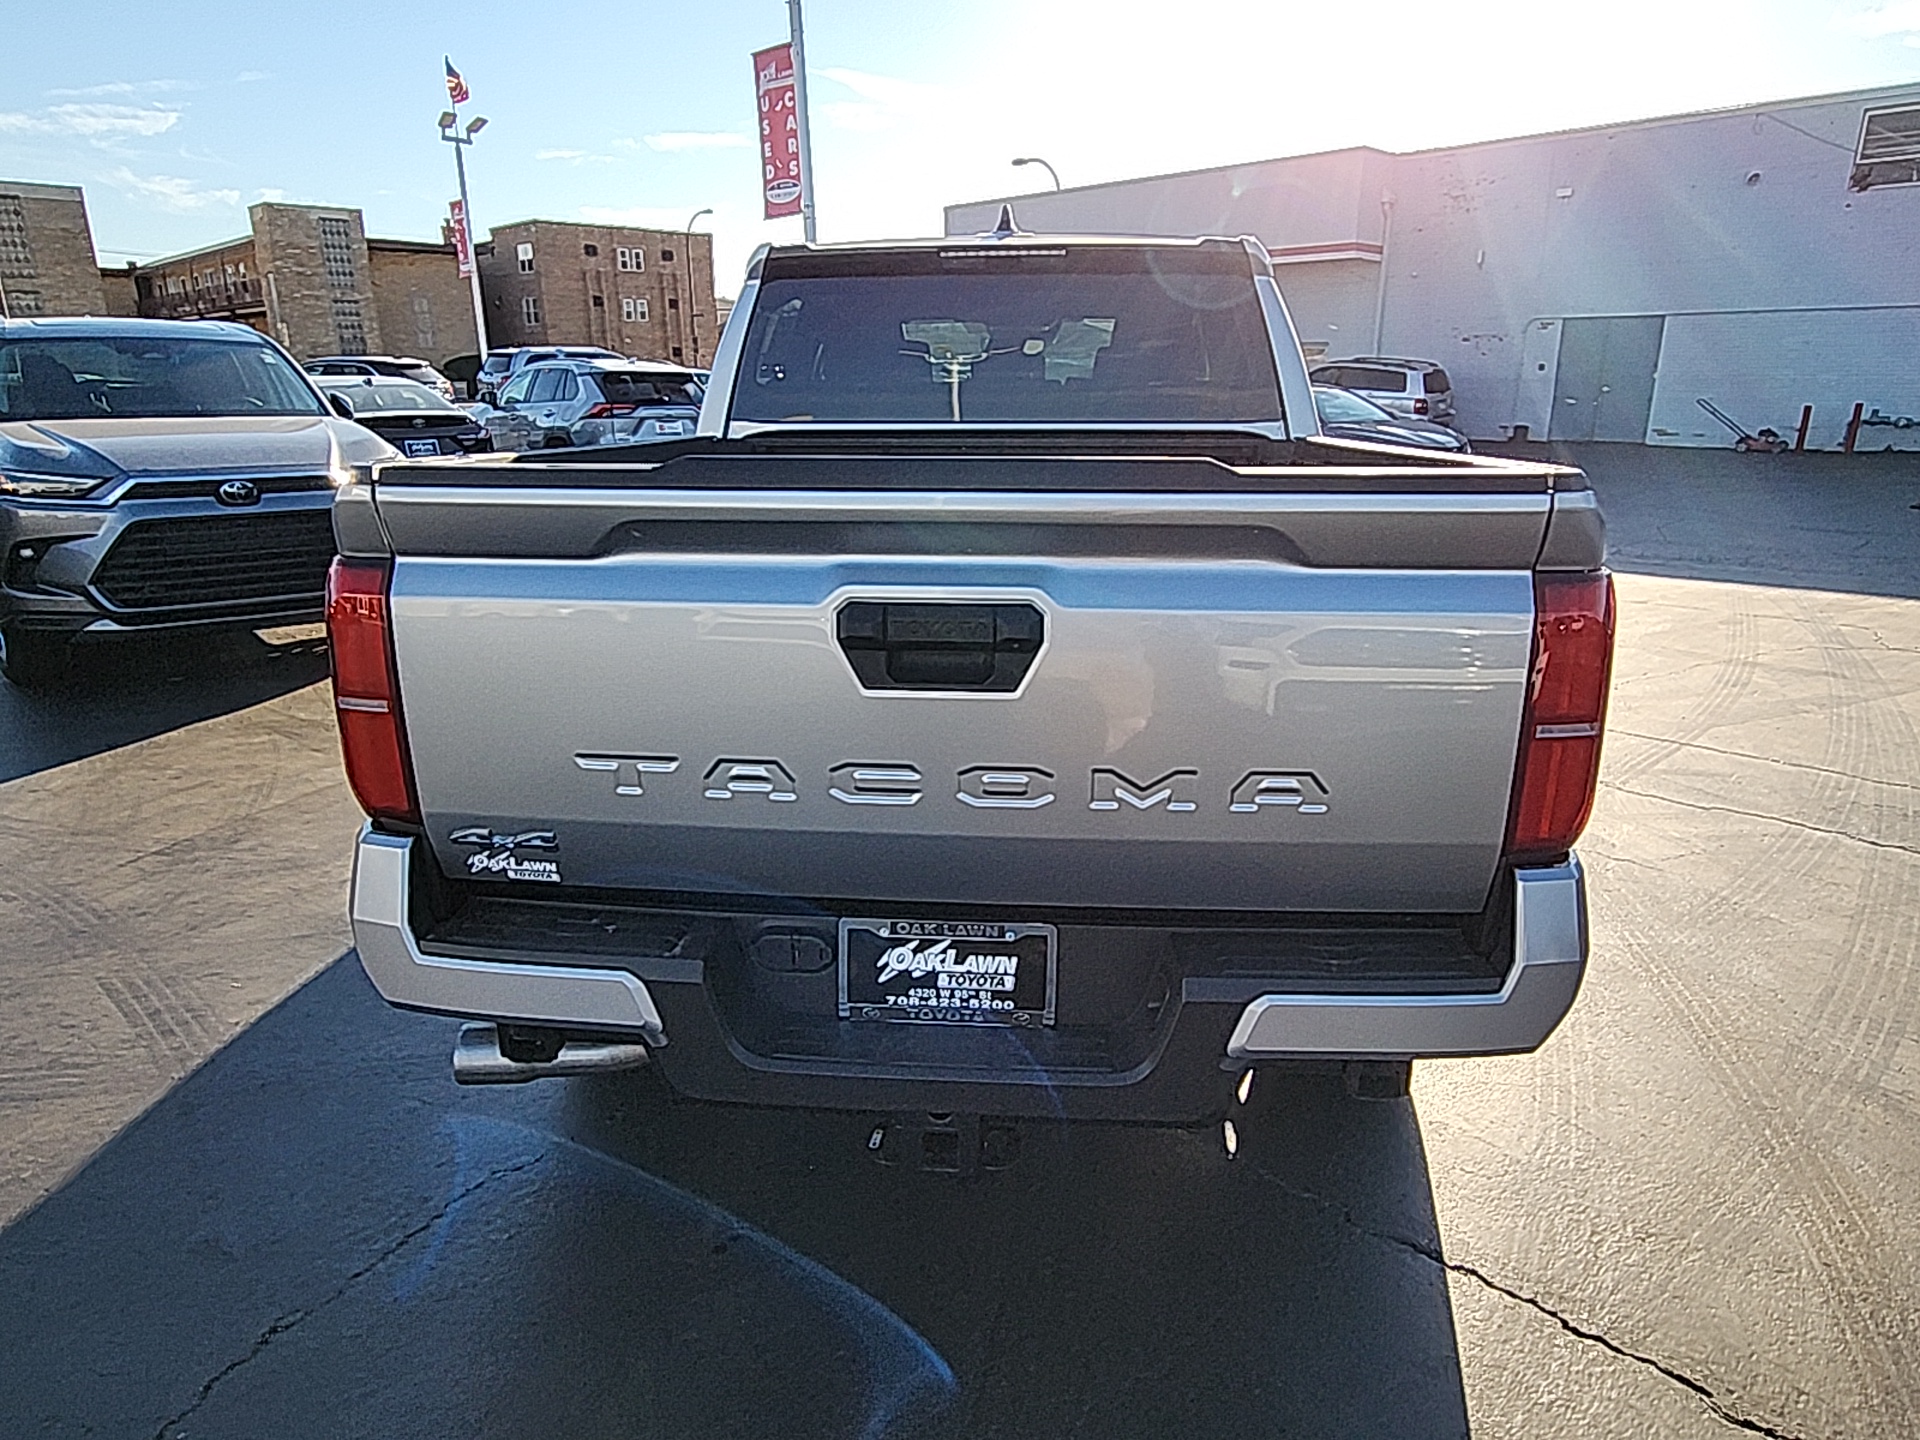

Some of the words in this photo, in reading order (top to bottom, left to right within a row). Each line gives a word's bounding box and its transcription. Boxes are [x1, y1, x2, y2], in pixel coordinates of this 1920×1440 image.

[760, 95, 775, 179] USED
[784, 91, 799, 176] CARS
[891, 618, 987, 637] TOYOTA
[574, 751, 1330, 813] TACOMA
[513, 870, 553, 880] TOYOTA
[896, 922, 938, 935] OAK
[943, 924, 999, 937] LAWN
[946, 974, 1007, 988] TOYOTA
[907, 987, 937, 998] 4320
[940, 989, 951, 998] W
[954, 989, 977, 999] 95
